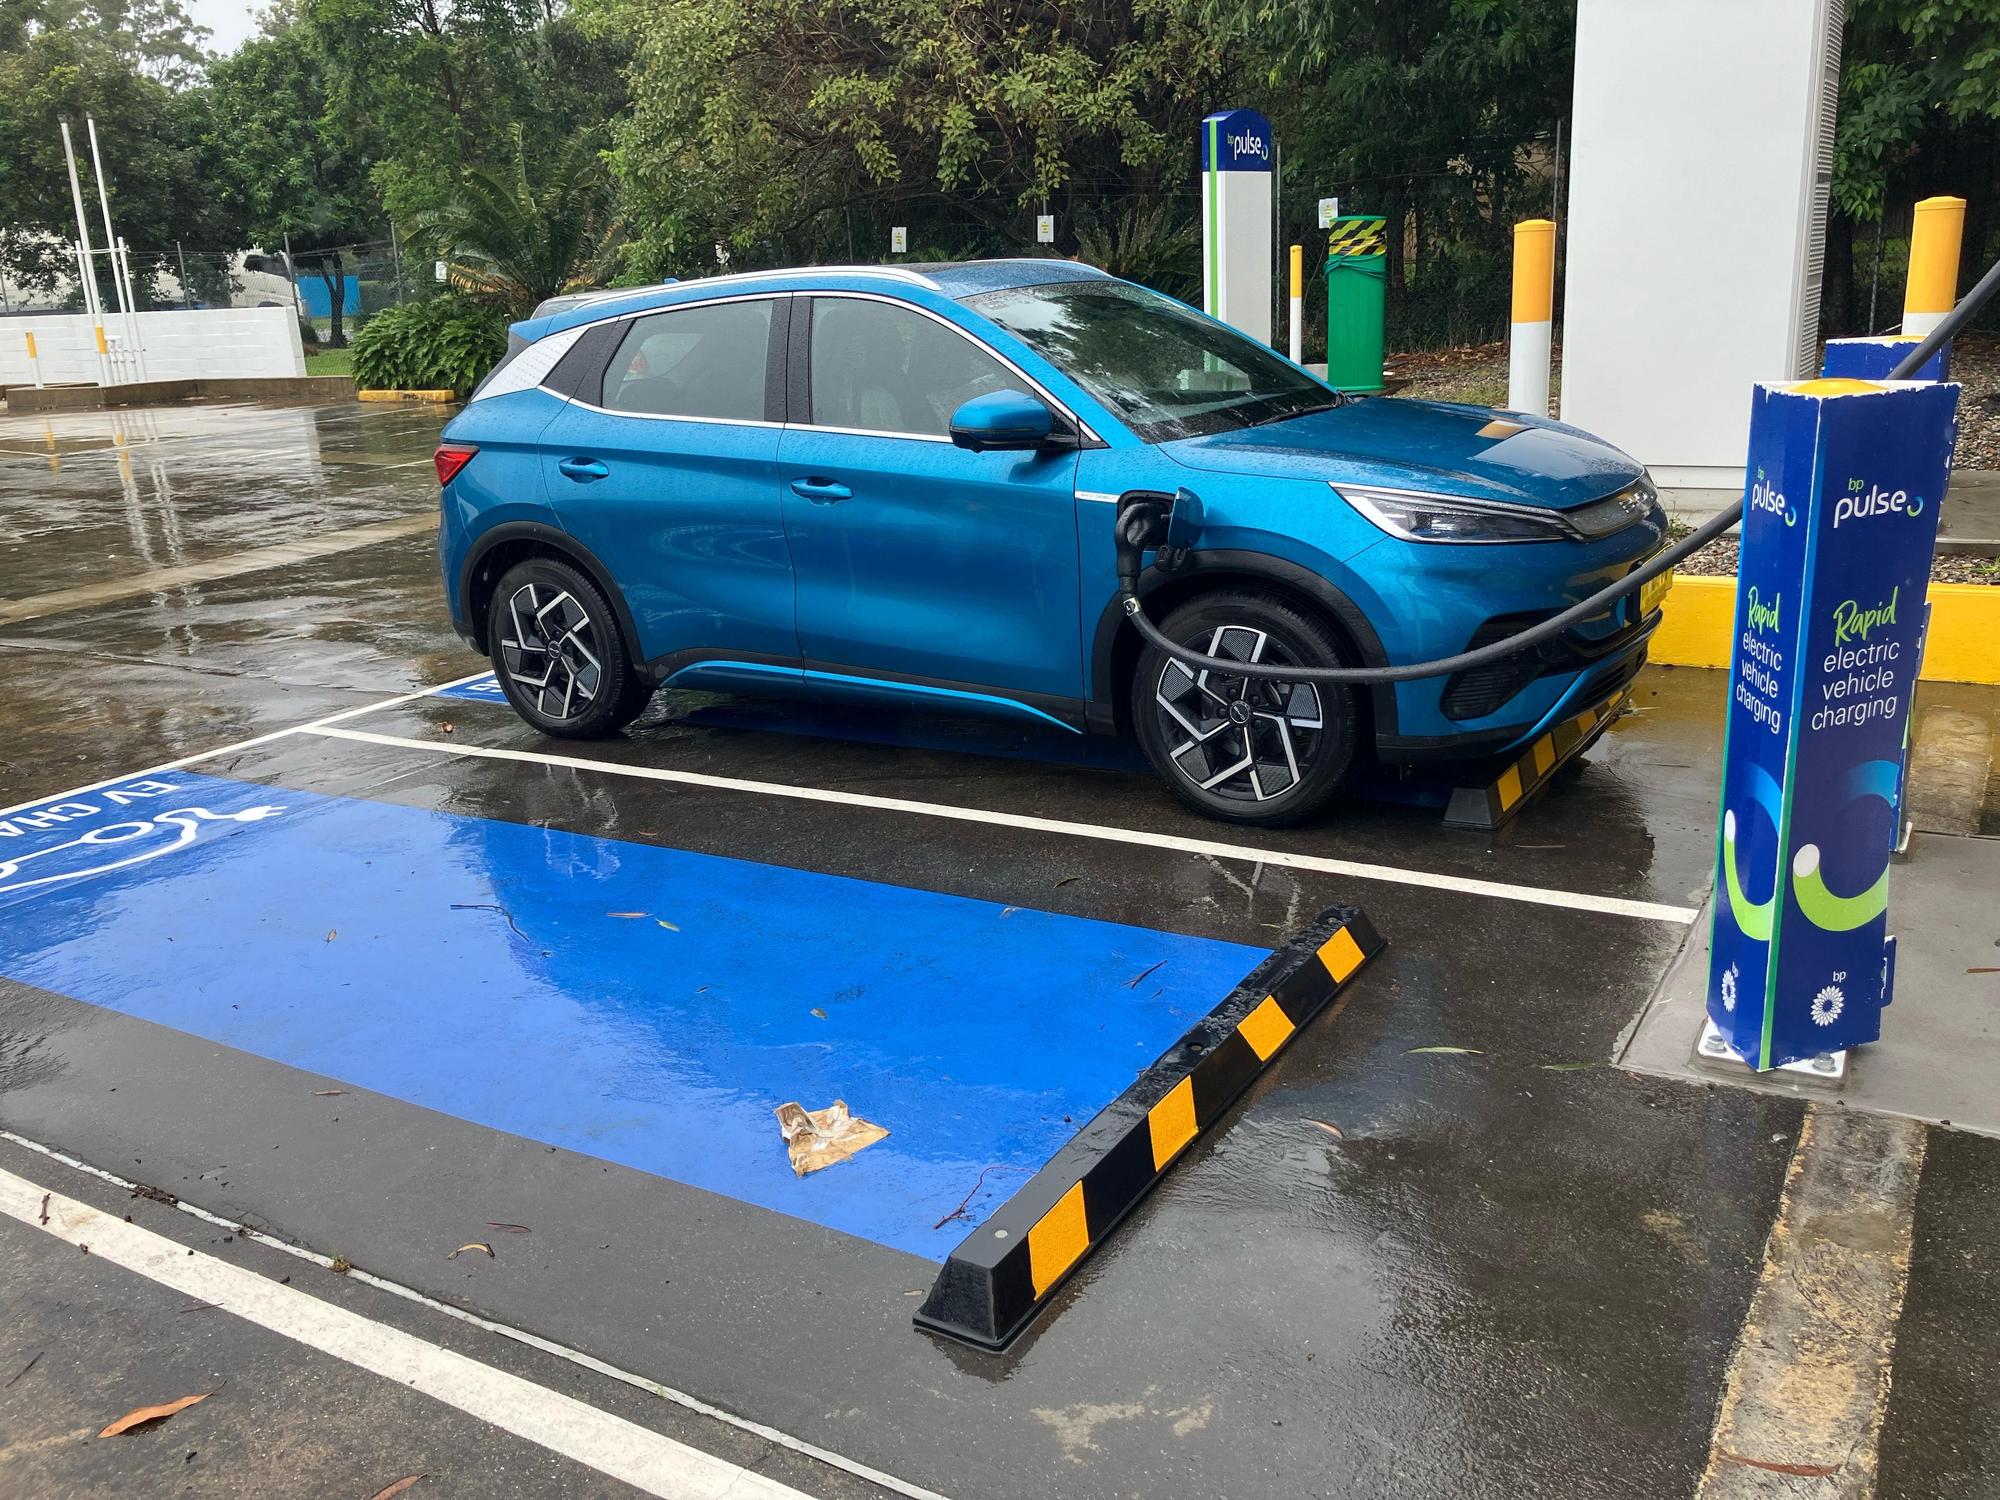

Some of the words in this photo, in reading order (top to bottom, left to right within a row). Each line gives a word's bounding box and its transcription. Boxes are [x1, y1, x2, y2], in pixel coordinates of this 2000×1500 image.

[1227, 133, 1235, 147] bp
[1233, 128, 1262, 161] pulse
[1757, 464, 1766, 481] bp
[1847, 477, 1865, 493] bp
[1751, 479, 1786, 516] pulse
[1833, 484, 1907, 529] pulse
[1747, 585, 1781, 635] Rapid
[1832, 585, 1899, 648] Rapid
[1742, 630, 1783, 672] electric
[1823, 637, 1901, 673] electric
[1741, 658, 1779, 699] vehicle
[1822, 666, 1895, 701] vehicle
[1736, 682, 1782, 735] charging
[1811, 694, 1898, 731] charging
[101, 780, 182, 805] EV
[1832, 970, 1847, 983] bp
